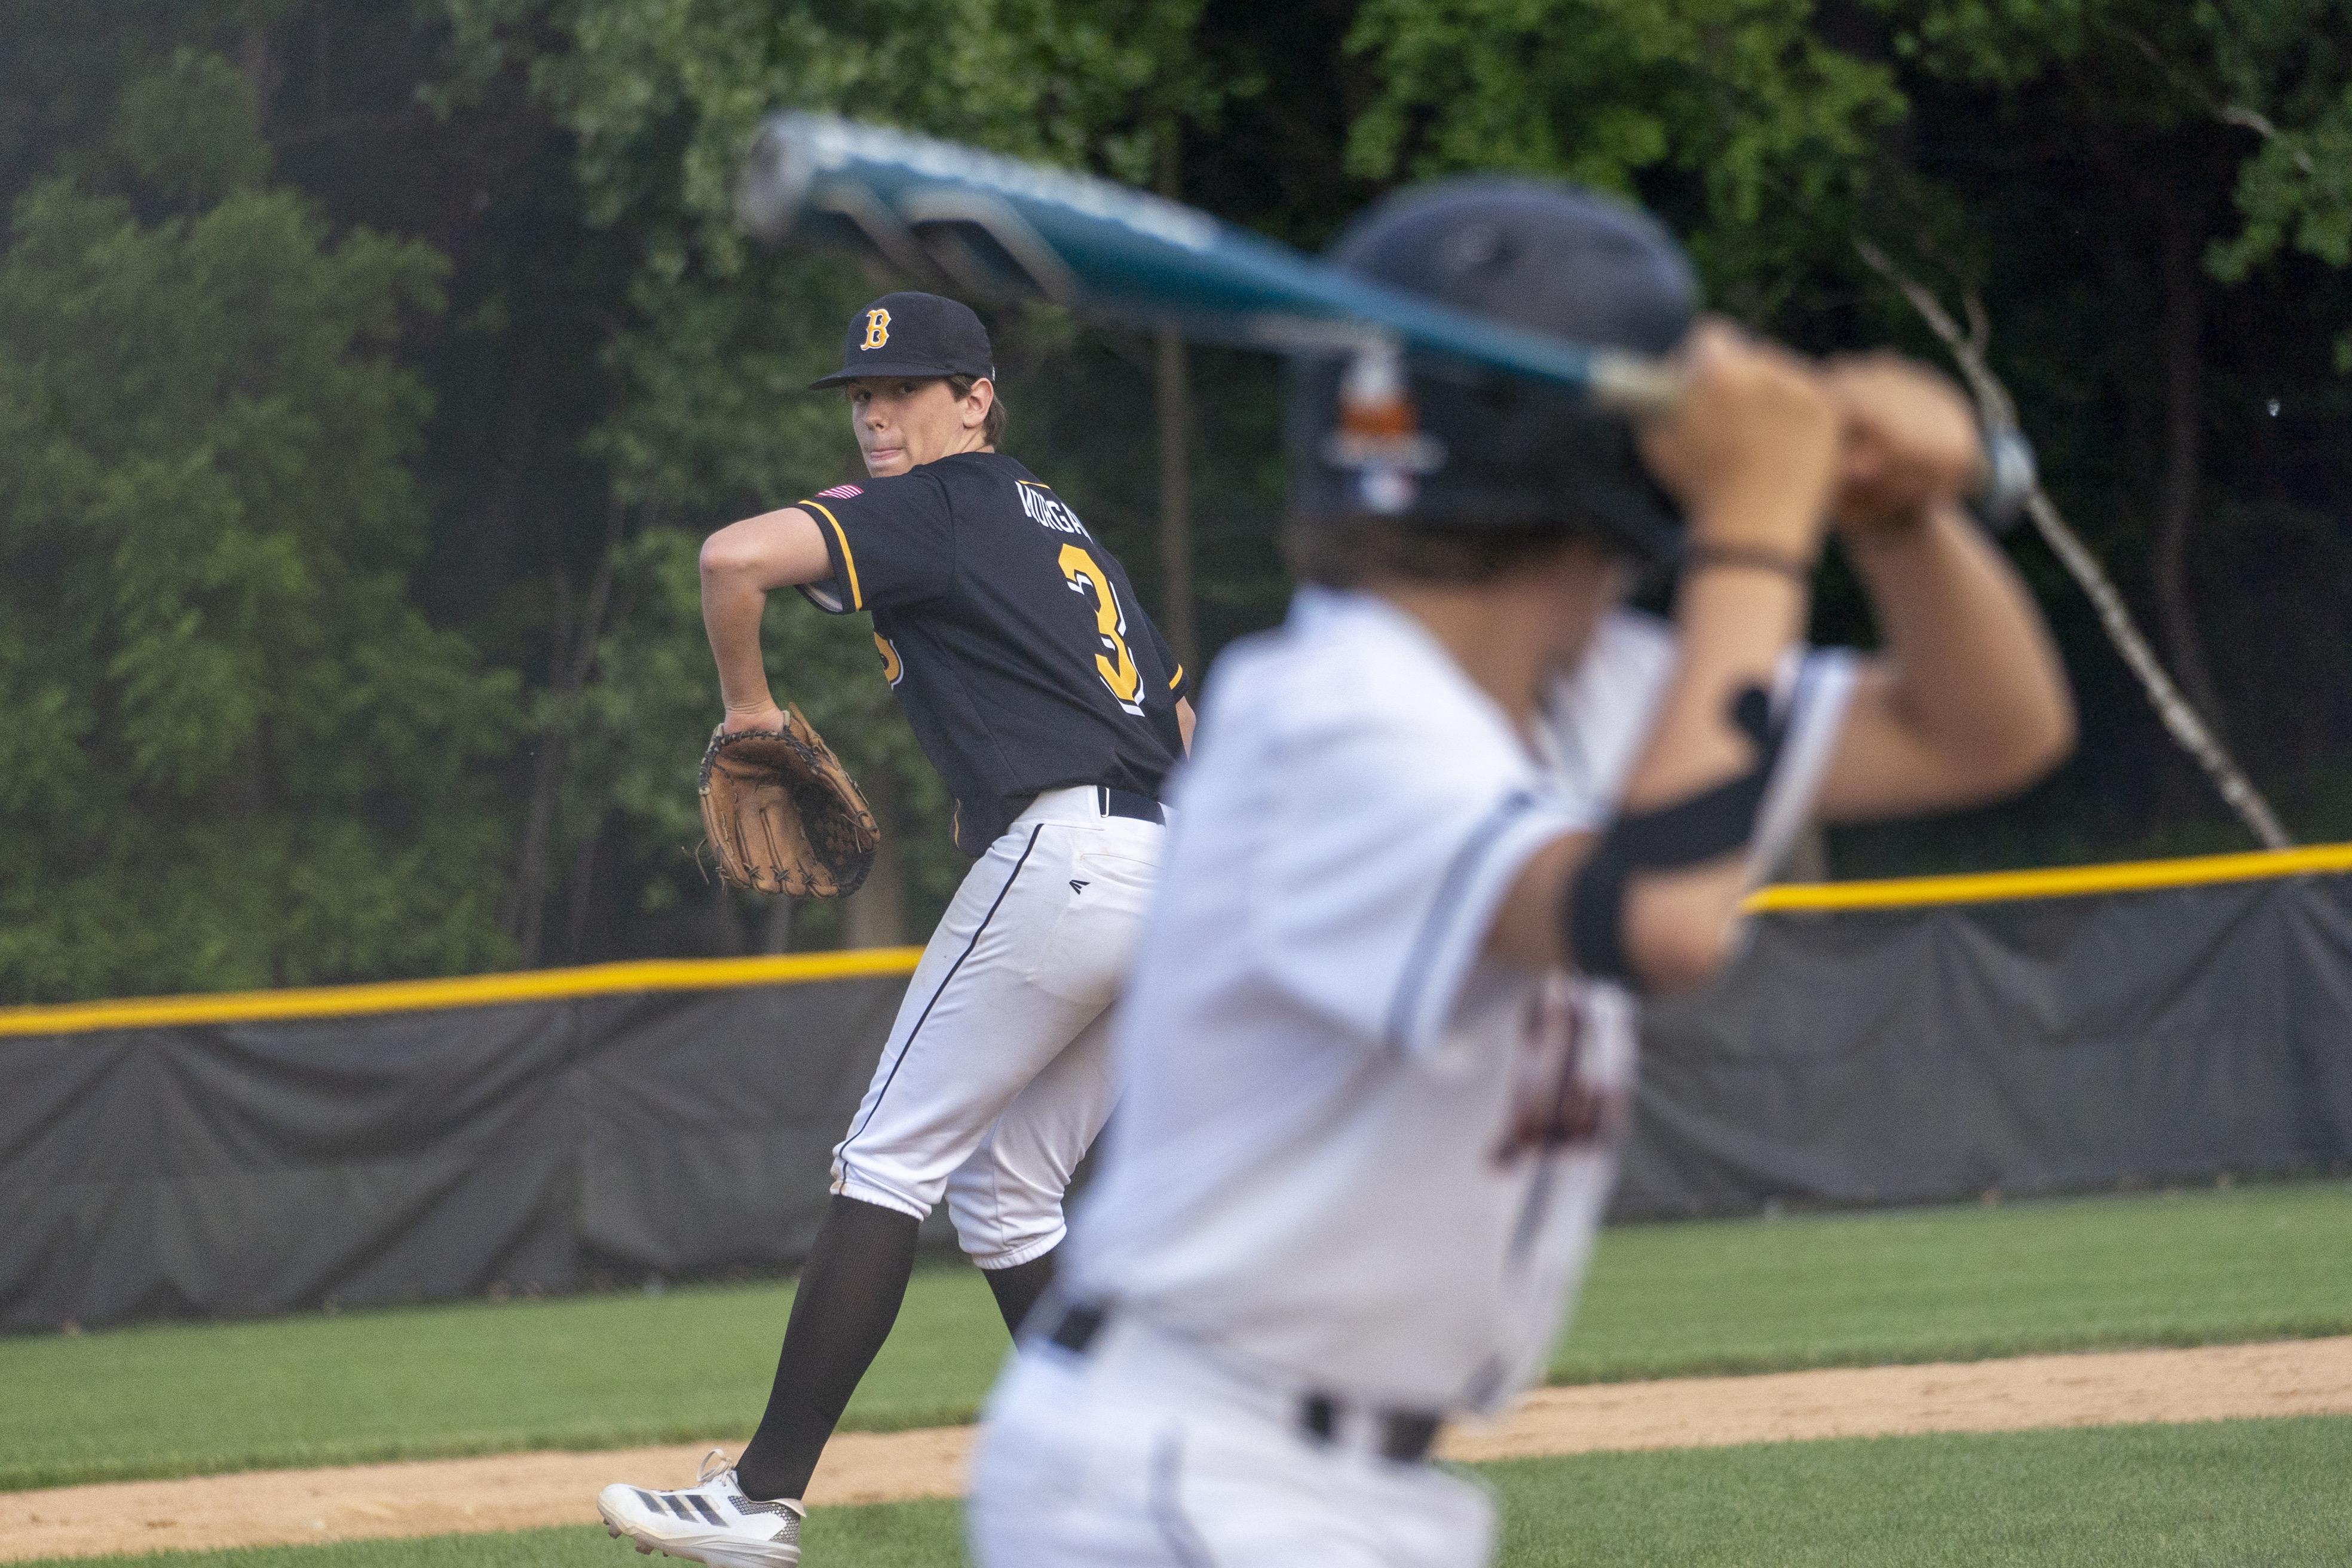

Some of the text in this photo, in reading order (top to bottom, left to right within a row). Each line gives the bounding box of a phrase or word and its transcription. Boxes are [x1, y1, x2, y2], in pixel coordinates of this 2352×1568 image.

[860, 308, 892, 351] B
[1015, 480, 1094, 544] MORGA
[1058, 543, 1146, 717] 3
